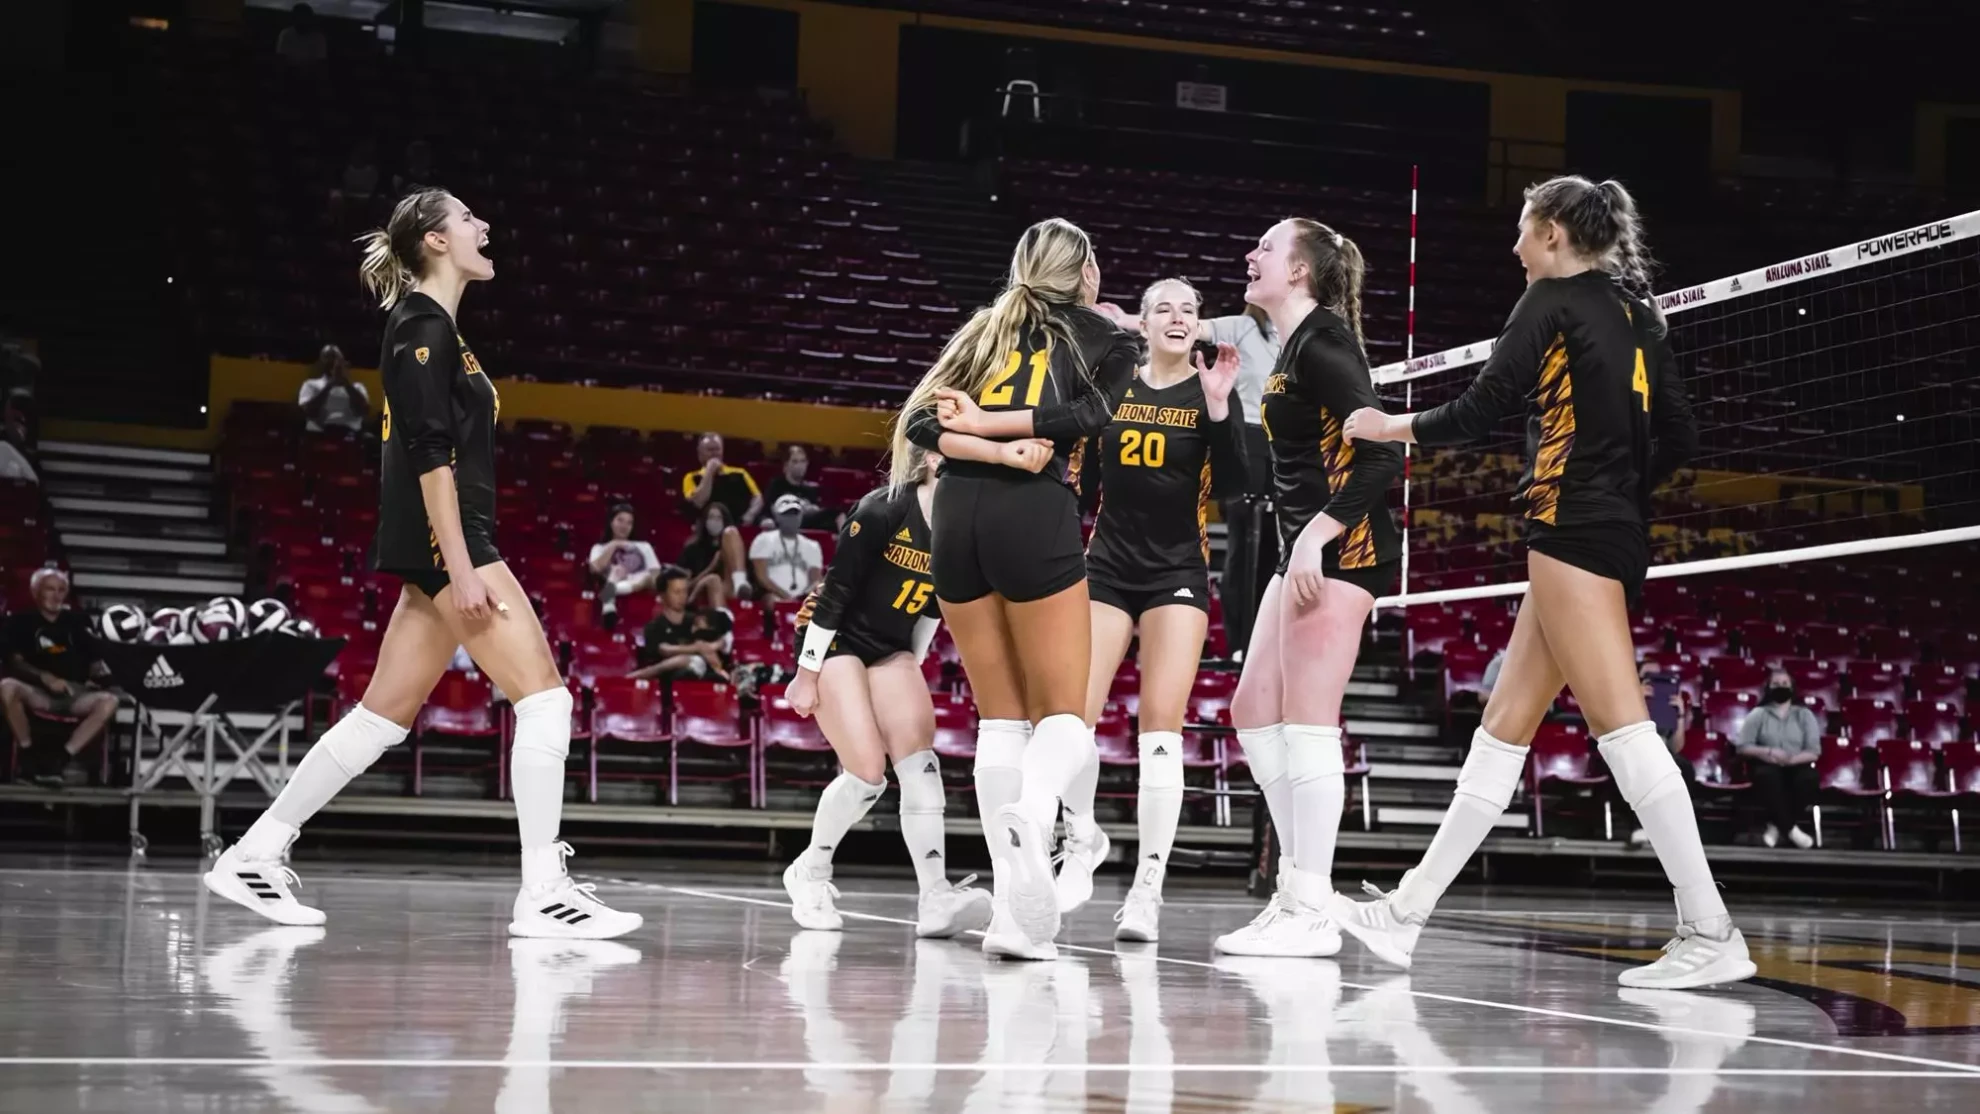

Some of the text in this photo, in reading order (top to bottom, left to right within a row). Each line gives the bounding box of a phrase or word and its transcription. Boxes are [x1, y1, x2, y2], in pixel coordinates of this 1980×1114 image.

[1857, 221, 1951, 260] POWERADE
[1765, 253, 1832, 282] ARIZONA STATE
[1682, 286, 1706, 304] STATE
[979, 349, 1049, 406] 21
[1632, 347, 1649, 413] 4
[1156, 407, 1199, 429] STATE
[1120, 429, 1165, 468] 20
[892, 579, 935, 614] 15
